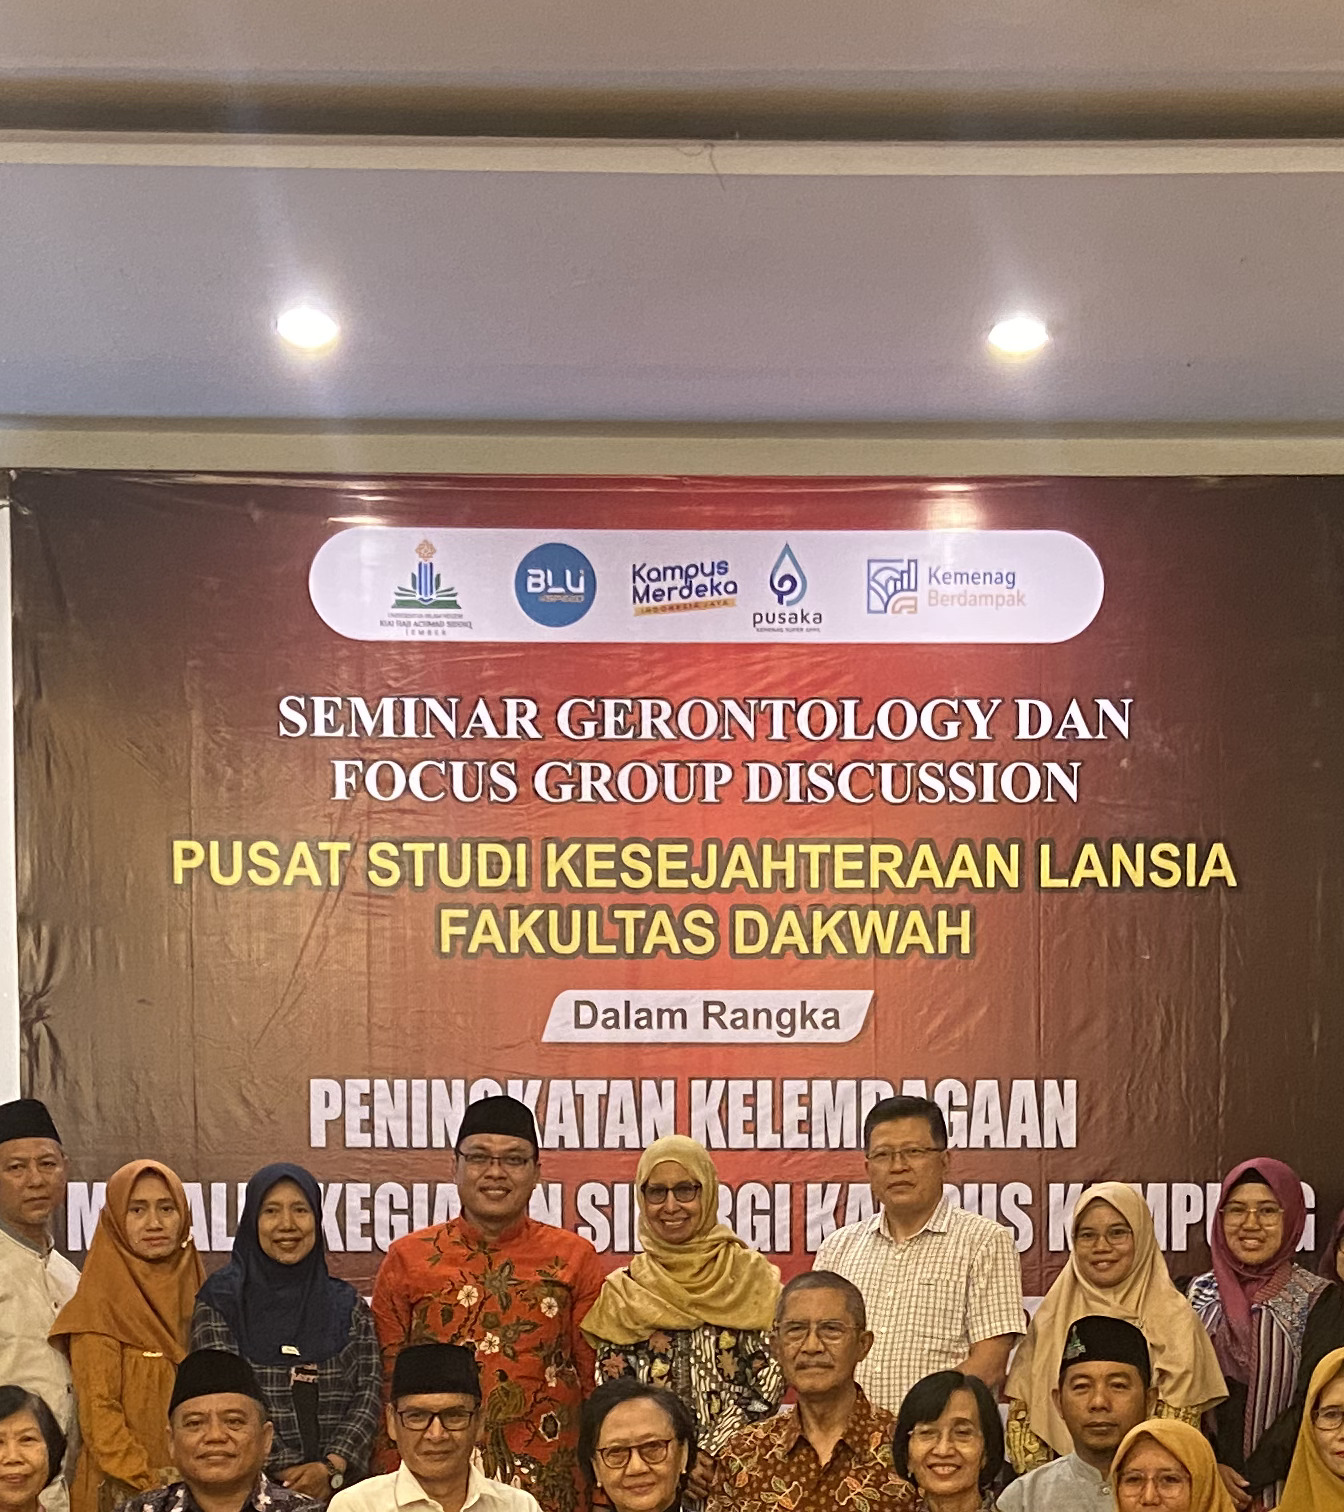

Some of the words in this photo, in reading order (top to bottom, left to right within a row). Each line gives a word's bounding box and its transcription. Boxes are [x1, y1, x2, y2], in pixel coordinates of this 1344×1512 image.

[526, 568, 584, 594] BLU
[632, 560, 729, 587] Kampus
[928, 564, 1016, 590] Kemenag
[632, 577, 738, 605] Merdeka
[928, 588, 1027, 611] Berdampak
[752, 608, 823, 629] pusaka
[277, 695, 544, 741] SEMINAR
[556, 697, 1002, 742] GERONTOLOGY
[1014, 698, 1135, 741] DAN
[330, 759, 519, 804] FOCUS
[533, 760, 734, 804] GROUP
[744, 760, 1083, 804] DISCUSSION
[171, 840, 353, 887] PUSAT
[366, 841, 528, 890] STUDI
[545, 841, 1021, 890] KESEJAHTERAAN
[1039, 841, 1239, 889] LANSIA
[439, 907, 716, 956] FAKULTAS
[733, 908, 973, 956] DAKWAH
[573, 1000, 687, 1030] Dalam
[701, 1000, 842, 1038] Rangka
